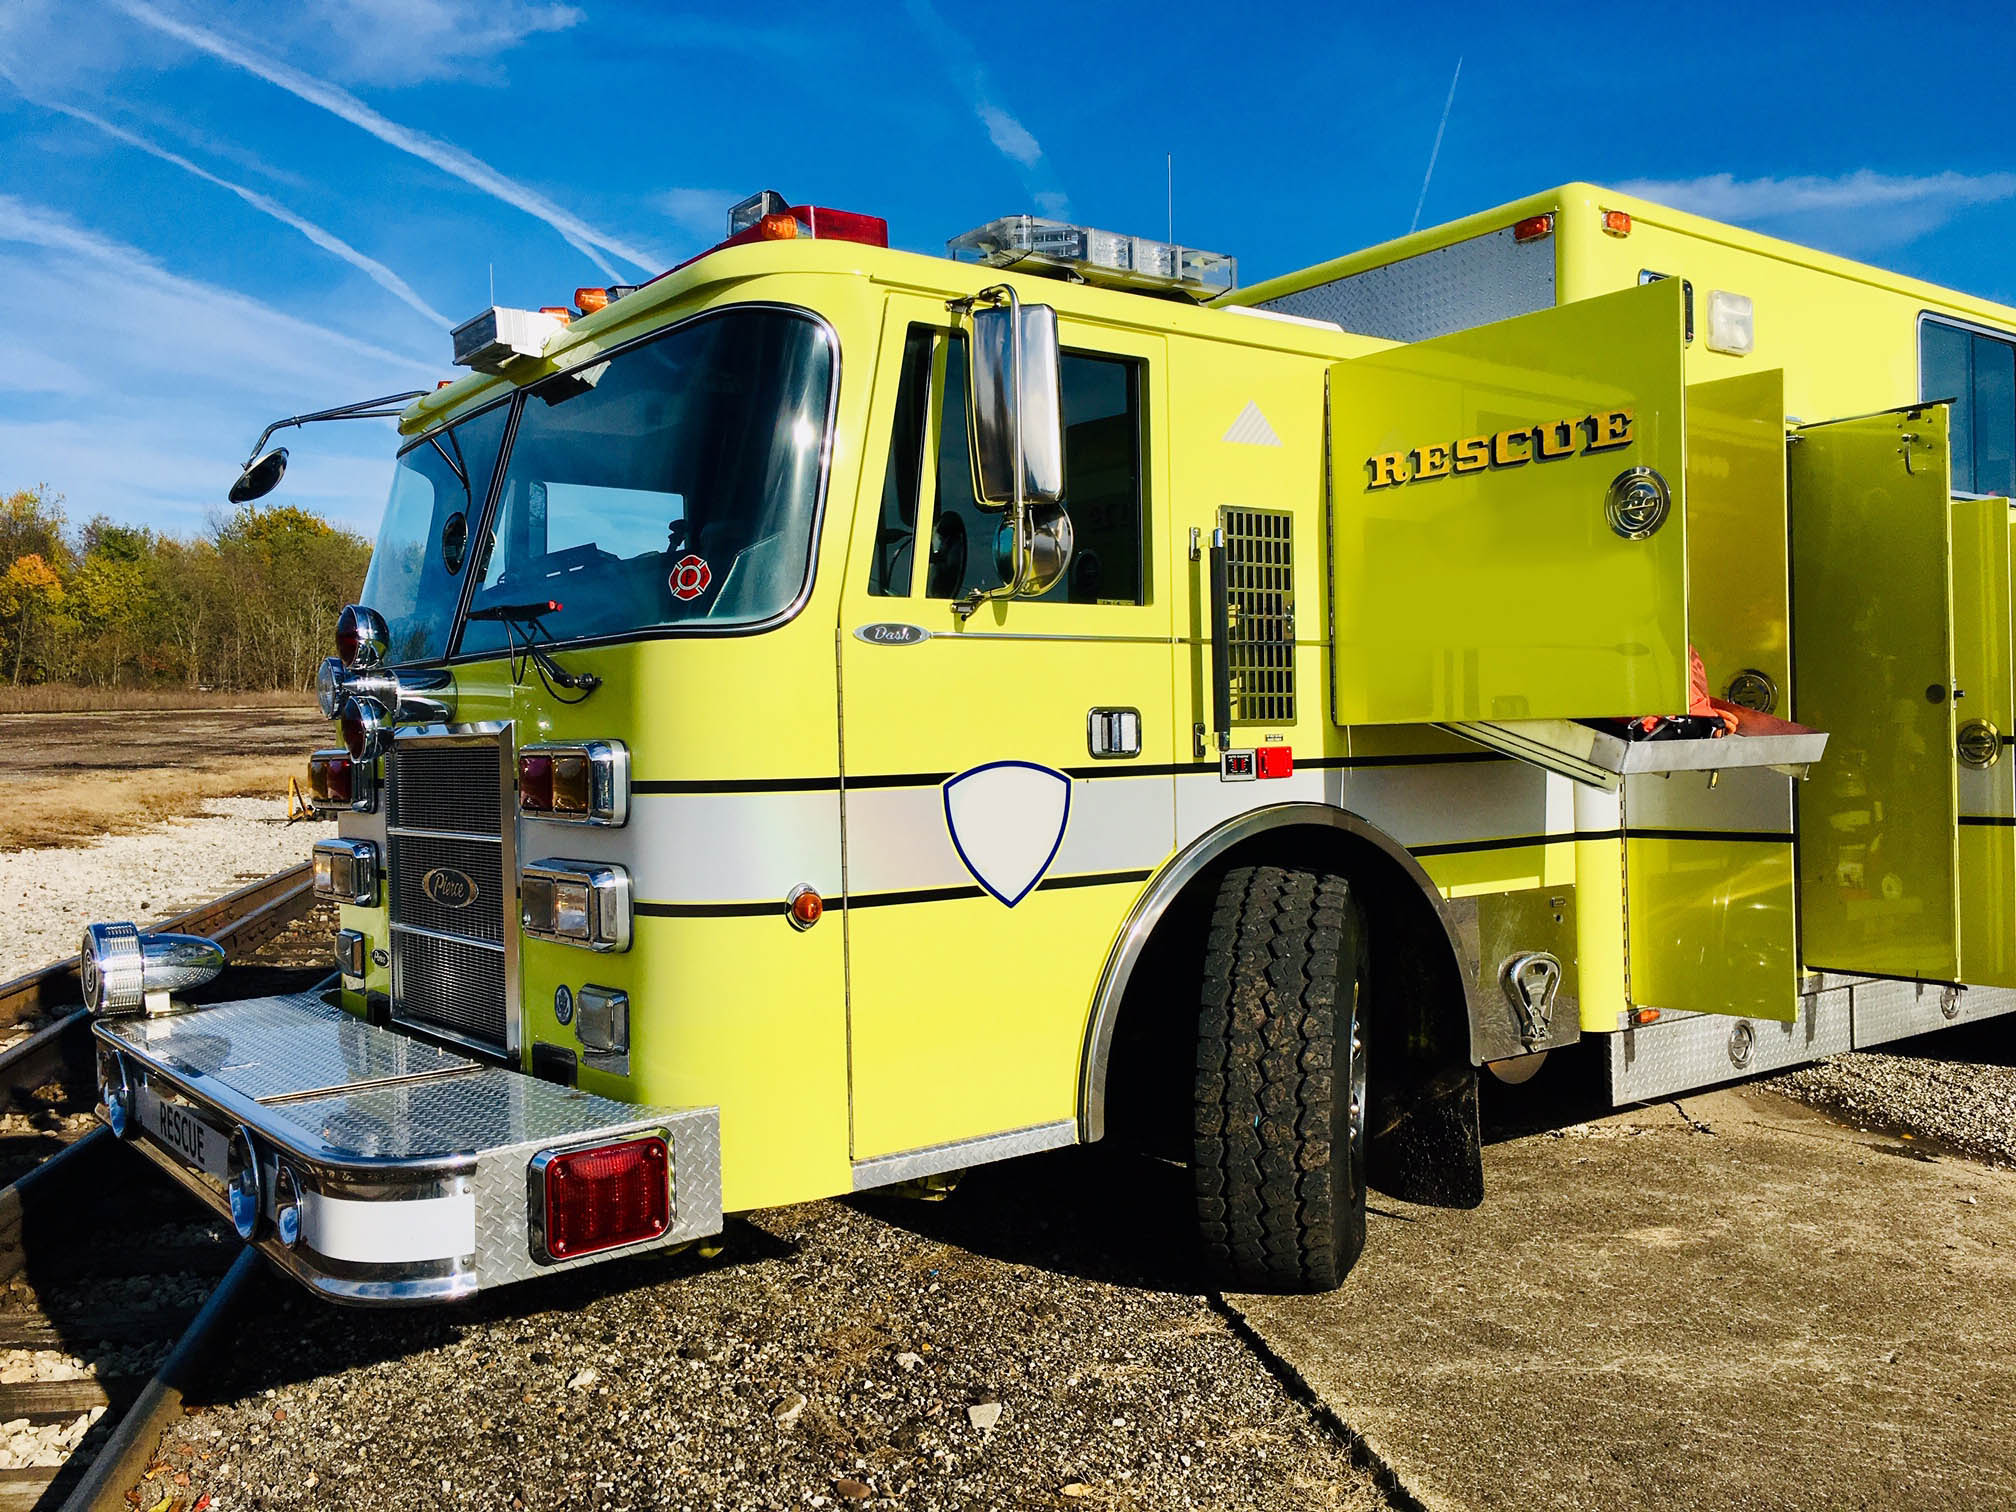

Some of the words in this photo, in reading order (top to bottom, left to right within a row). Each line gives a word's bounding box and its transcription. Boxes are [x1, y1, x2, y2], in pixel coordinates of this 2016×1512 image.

[1364, 408, 1634, 491] RESCUE
[874, 626, 911, 641] Dash
[433, 872, 464, 898] Pierce
[159, 1100, 206, 1164] RESCUE
